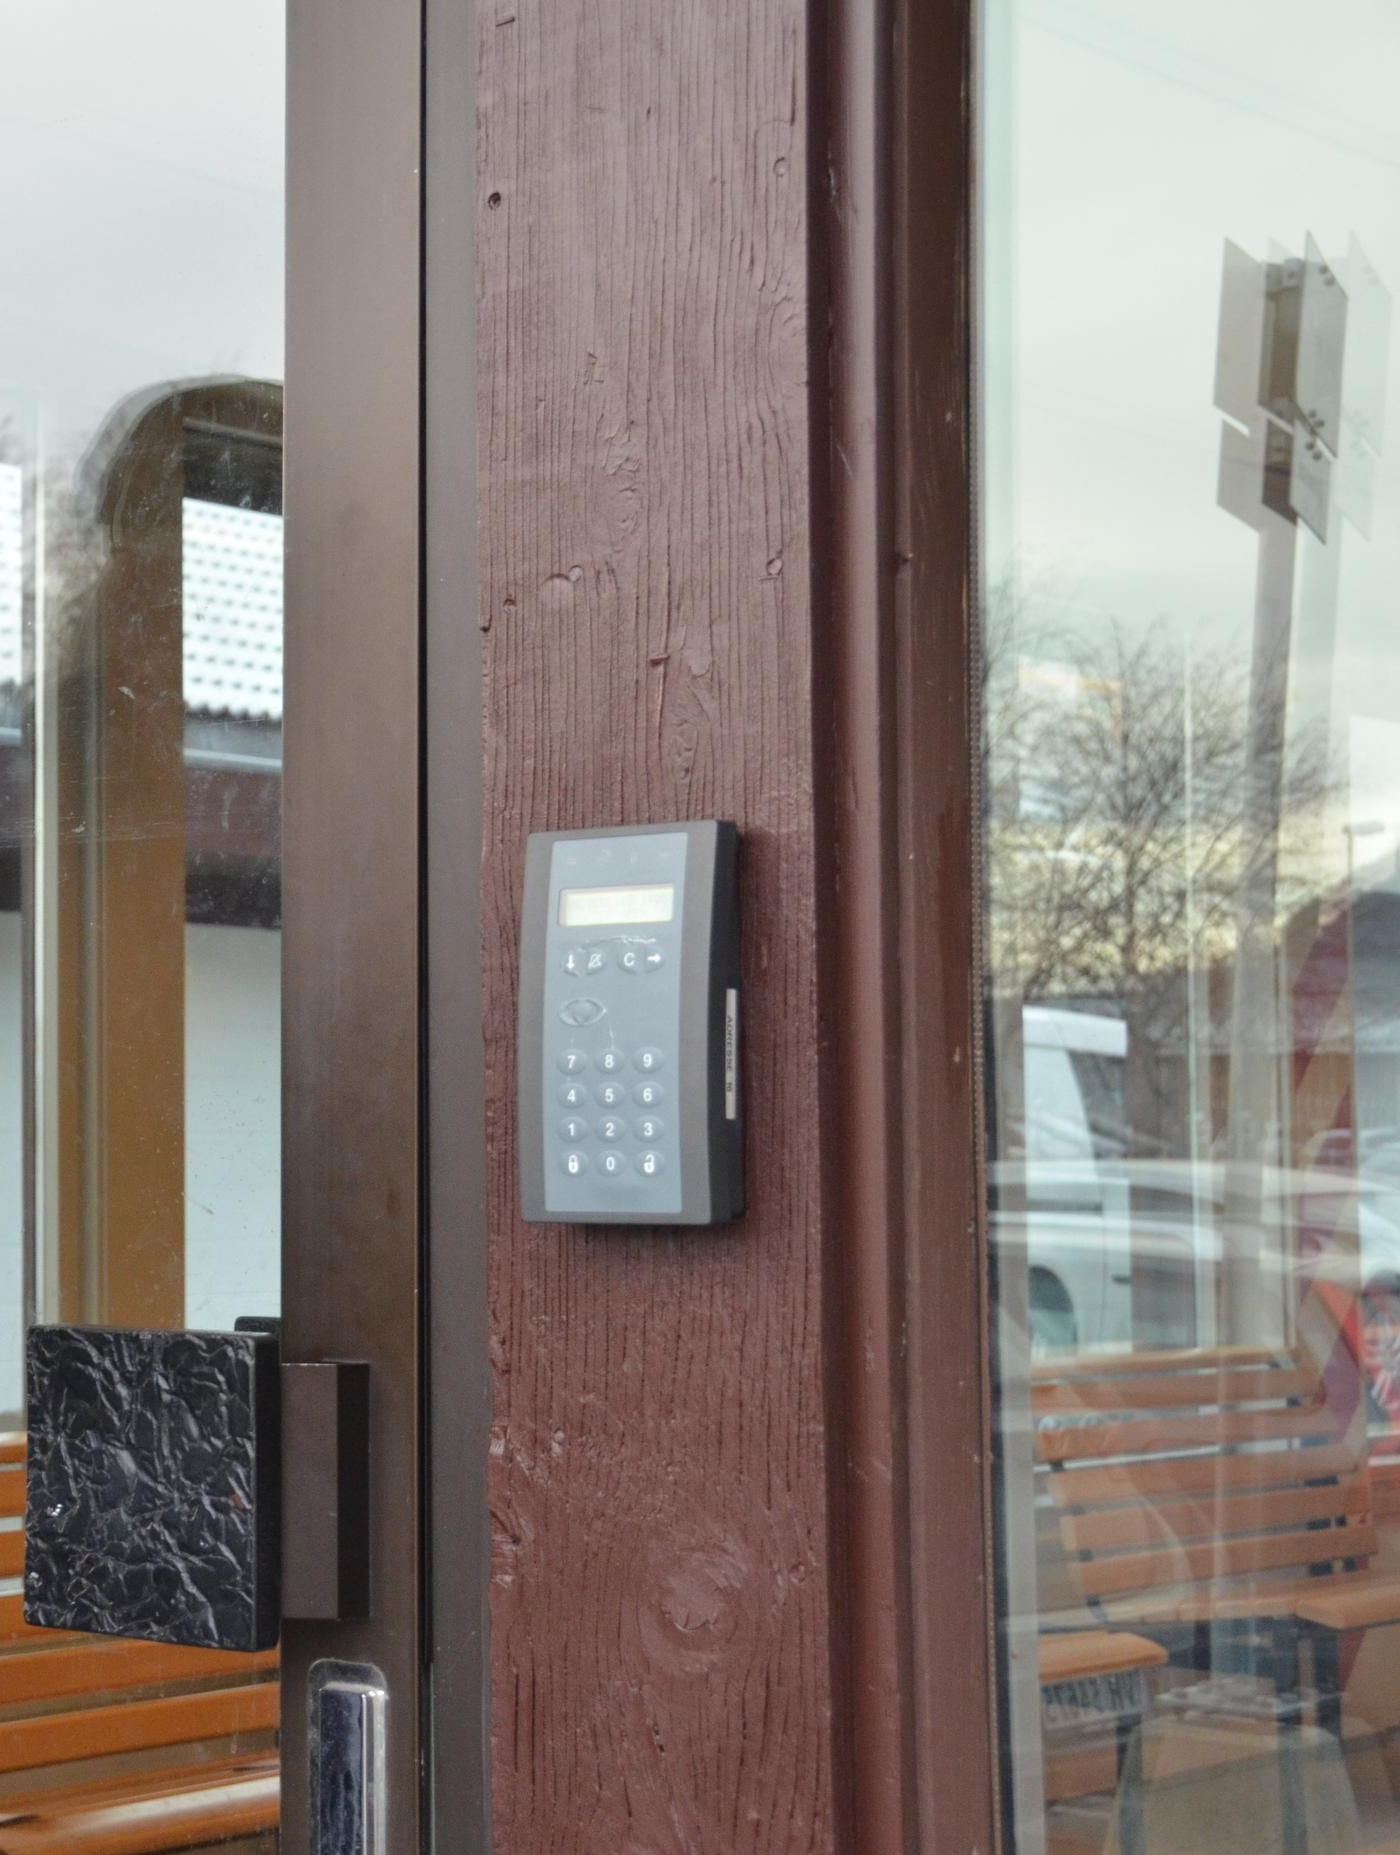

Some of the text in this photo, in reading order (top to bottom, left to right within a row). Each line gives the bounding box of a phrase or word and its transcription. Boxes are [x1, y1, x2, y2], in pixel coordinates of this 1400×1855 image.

[623, 951, 635, 967] C
[567, 1053, 653, 1069] 7 8 9
[567, 1087, 653, 1103] 4 5 6
[567, 1121, 653, 1137] 1 2 3
[606, 1156, 615, 1171] 0
